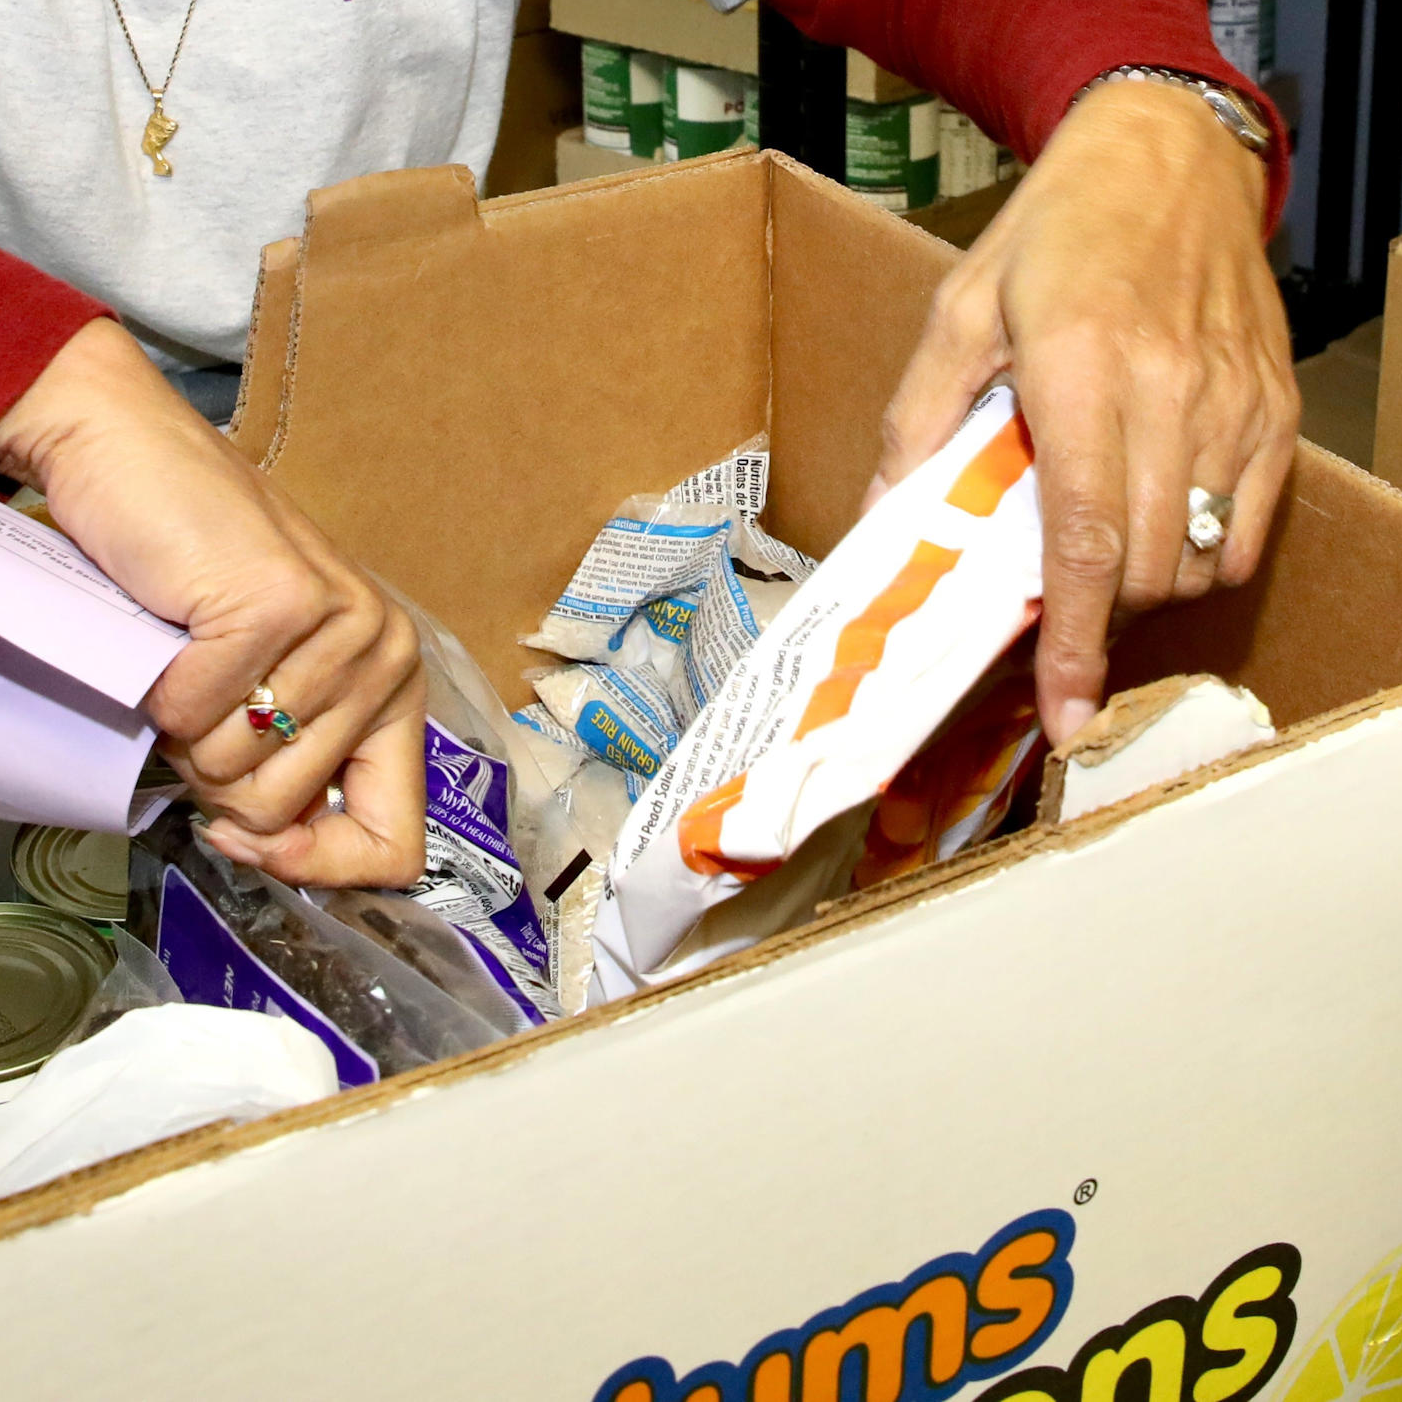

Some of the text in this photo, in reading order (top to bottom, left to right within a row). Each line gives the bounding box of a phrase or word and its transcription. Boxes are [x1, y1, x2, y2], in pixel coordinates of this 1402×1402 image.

[736, 458, 749, 507] Datos de
[749, 459, 764, 509] Nutrition
[771, 648, 788, 687] grilled
[591, 707, 619, 741] RICE
[617, 731, 656, 775] GRAIN
[676, 740, 704, 802] Signature
[447, 812, 461, 826] TO
[641, 761, 678, 837] Peach Salad:
